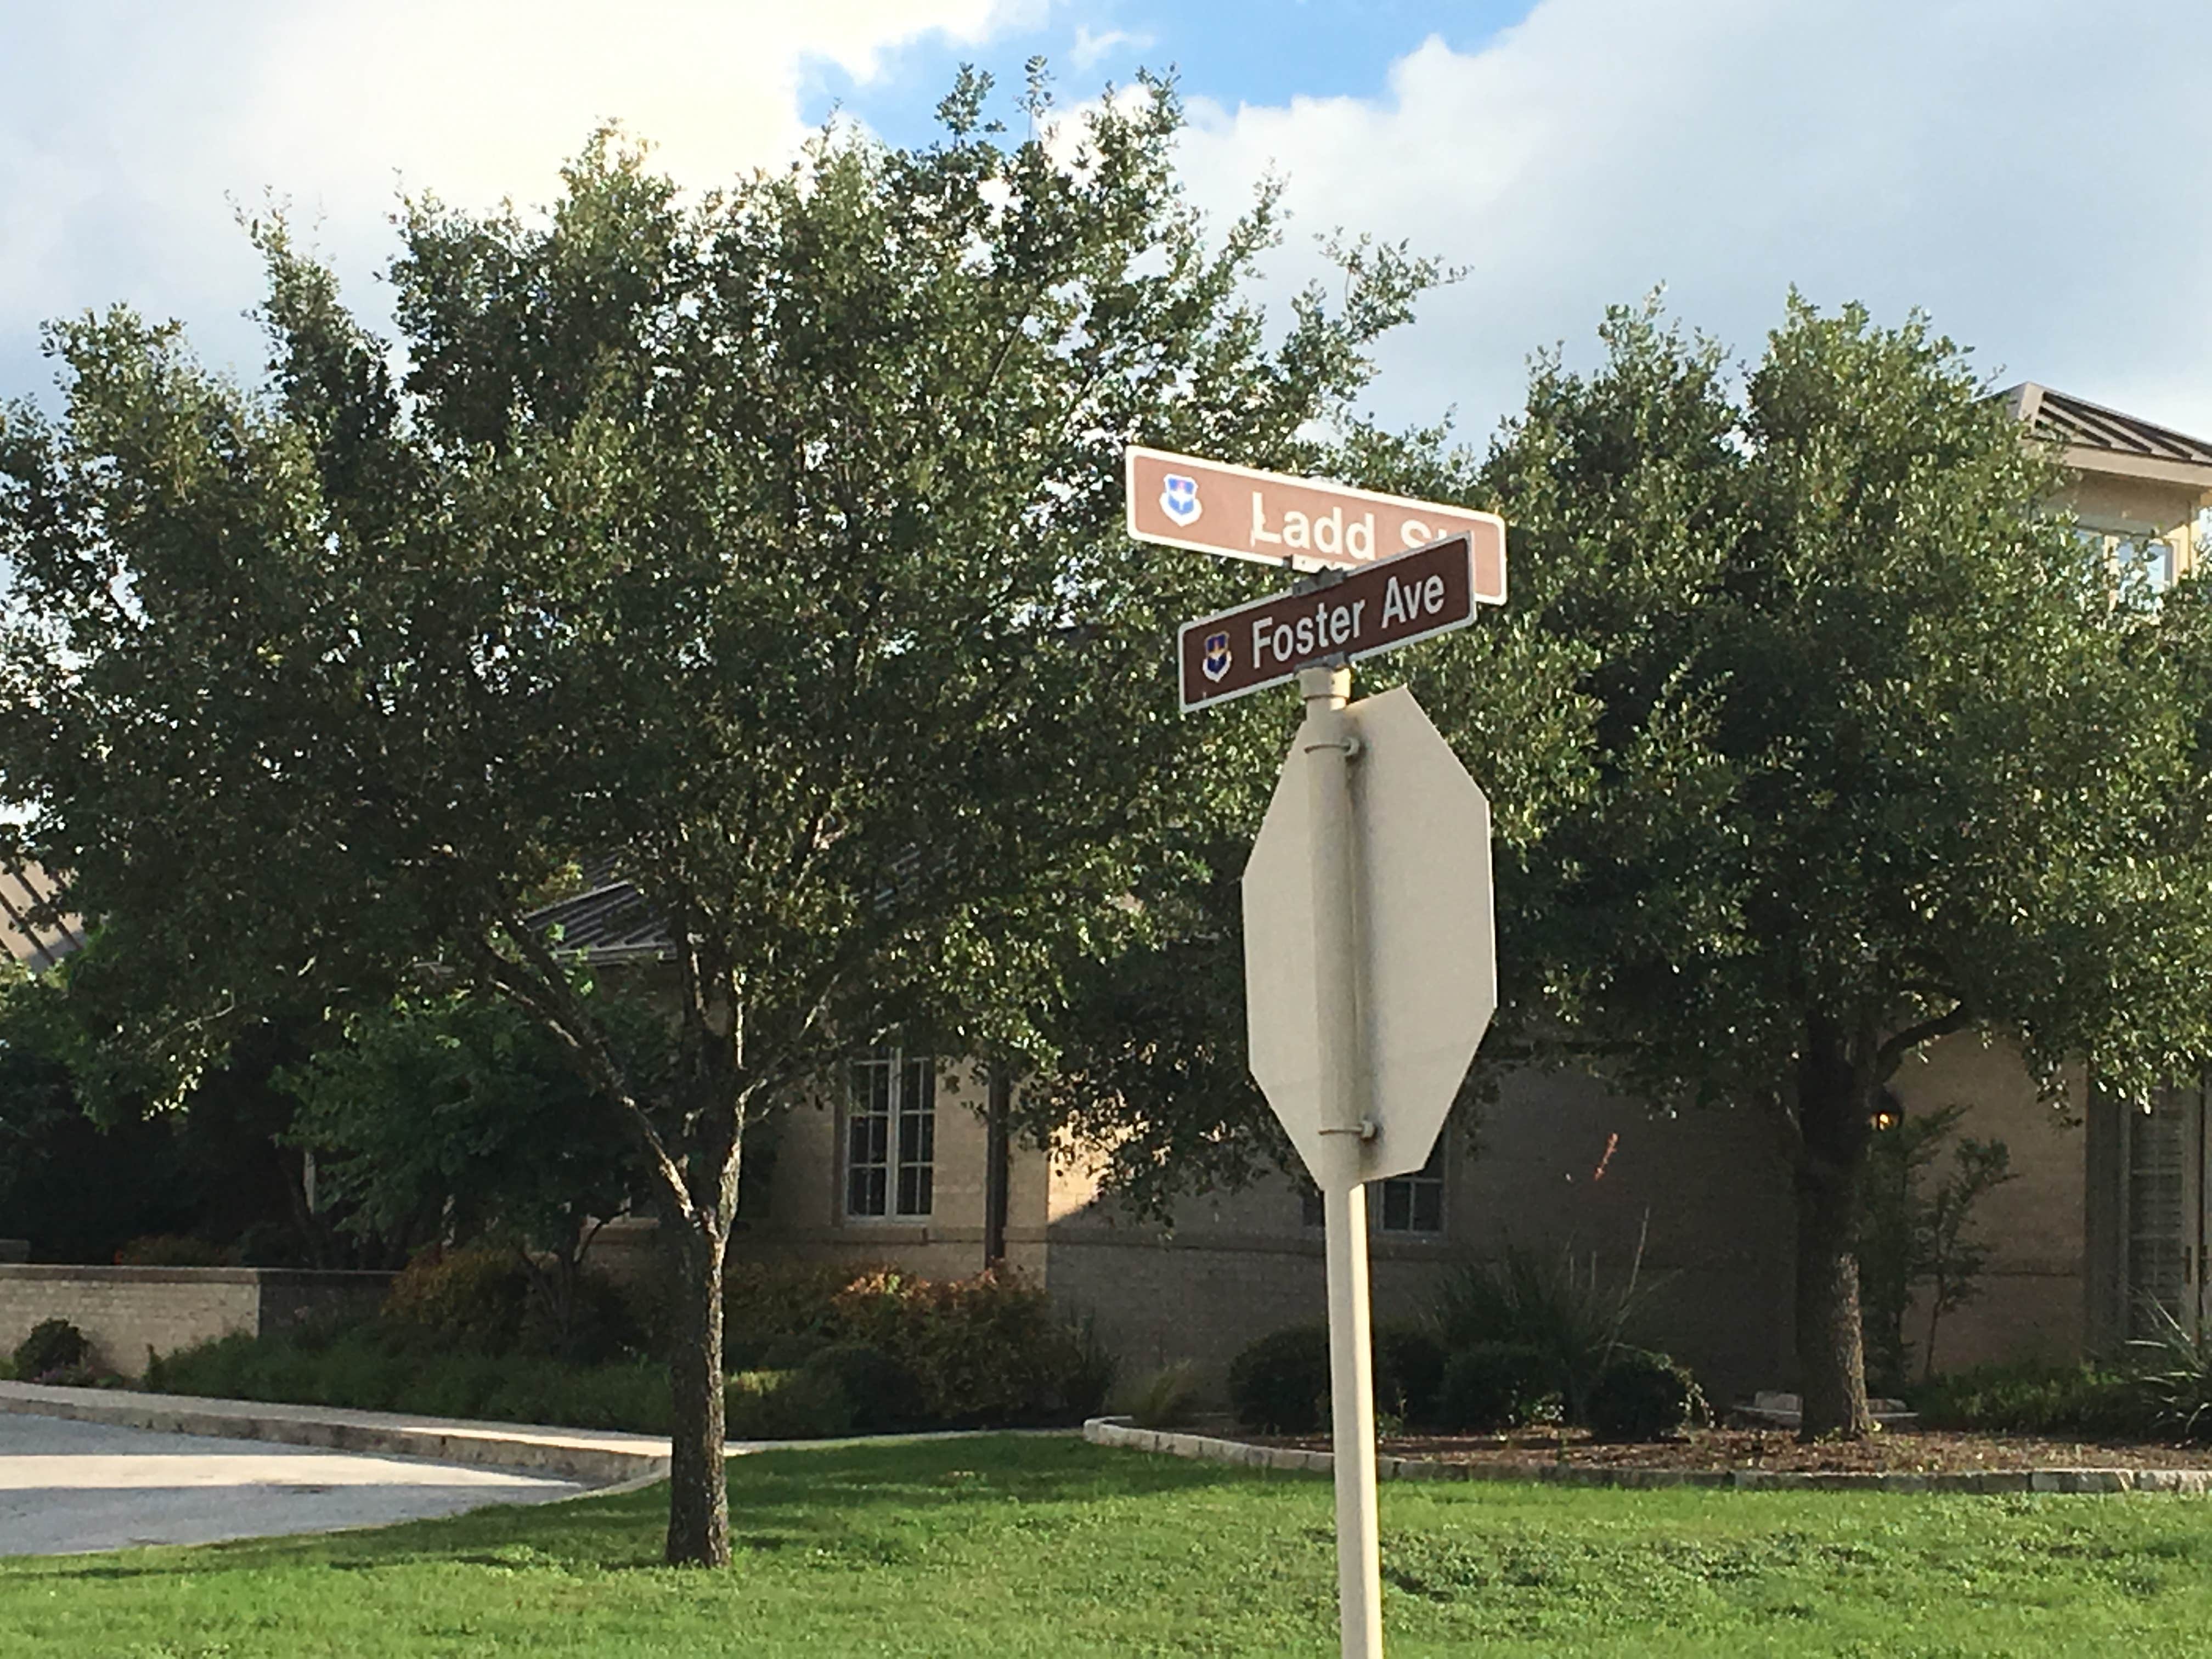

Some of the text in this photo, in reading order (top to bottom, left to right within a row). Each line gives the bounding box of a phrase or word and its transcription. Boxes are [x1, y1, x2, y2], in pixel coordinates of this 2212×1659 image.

[1251, 492, 1448, 562] Ladd S
[1252, 575, 1444, 669] Foster Ave
